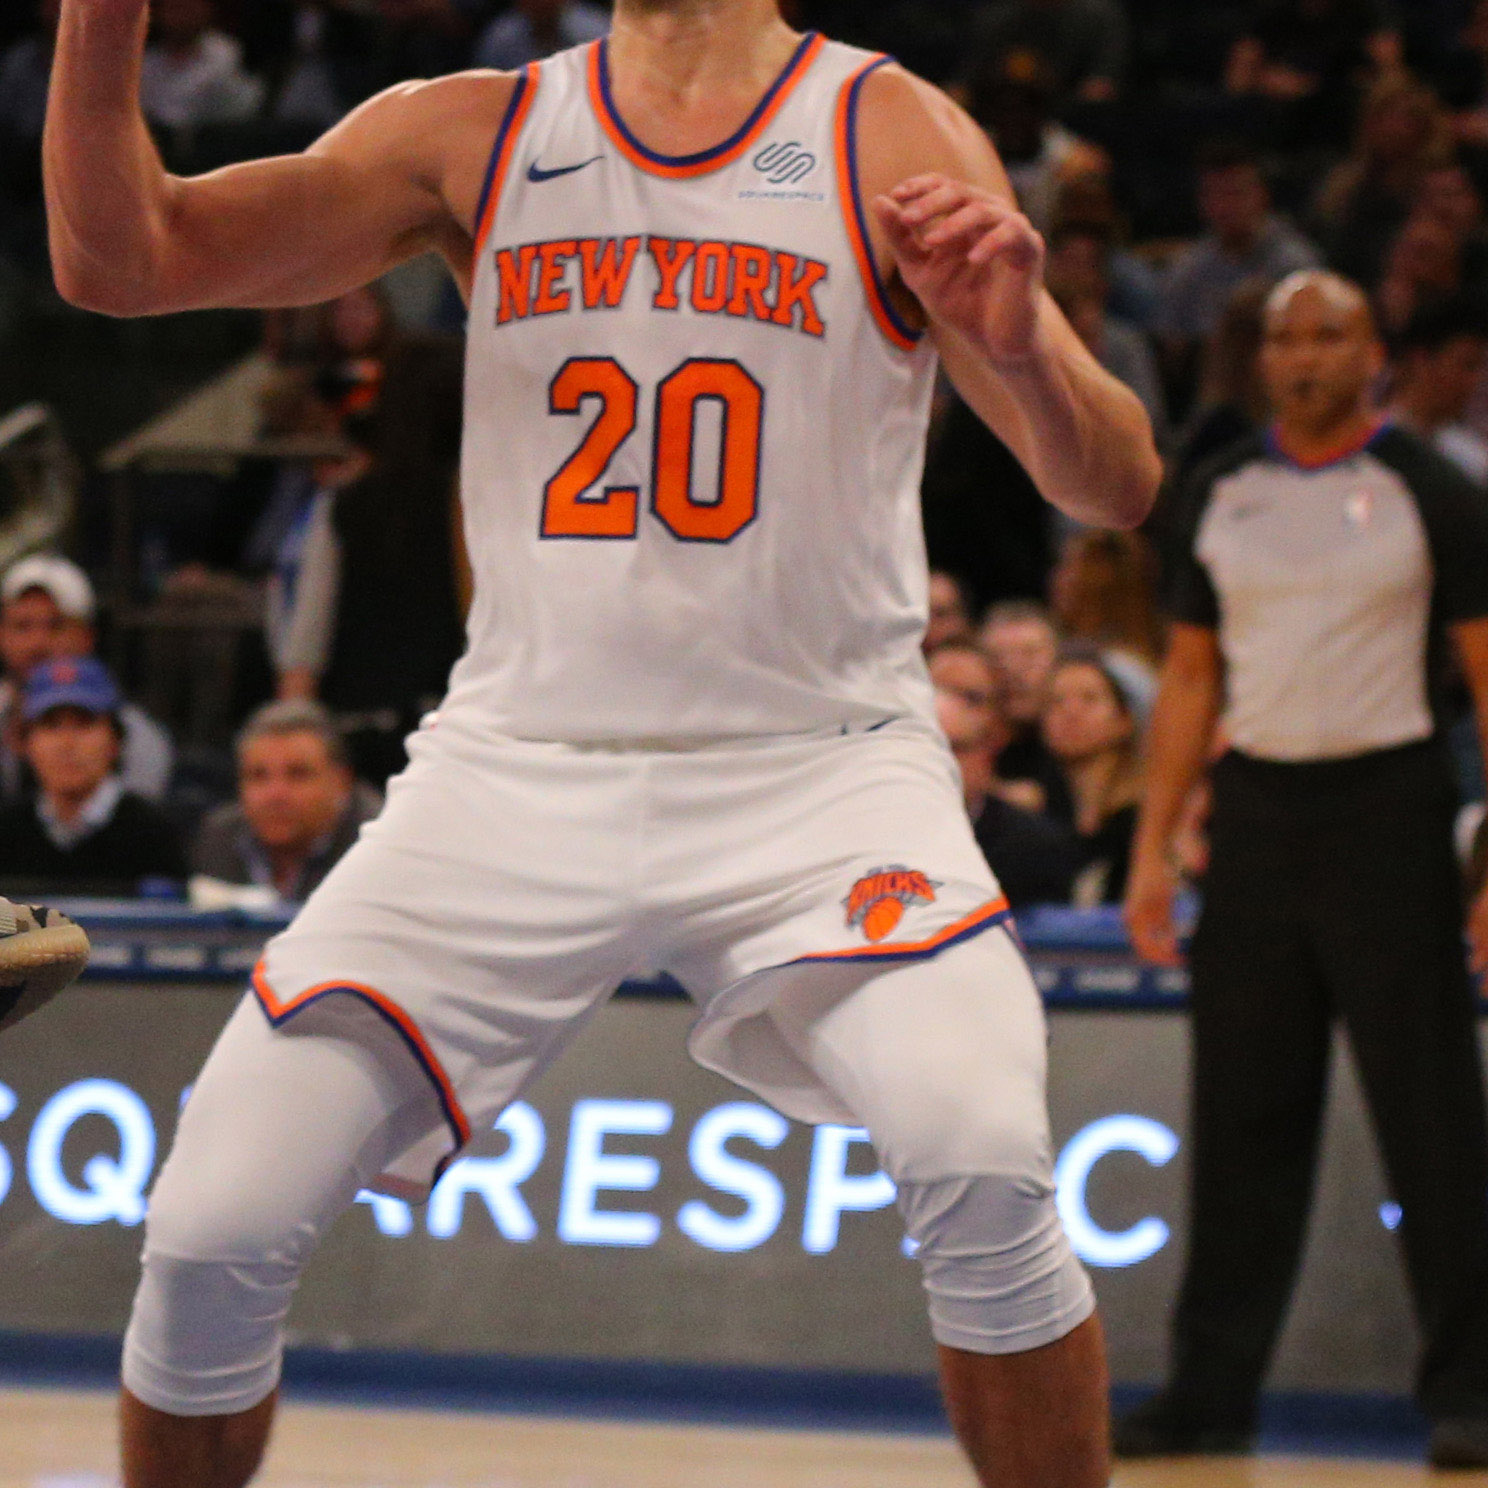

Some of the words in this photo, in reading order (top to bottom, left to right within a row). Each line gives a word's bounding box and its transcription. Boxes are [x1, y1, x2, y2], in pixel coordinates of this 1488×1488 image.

[494, 234, 645, 328] NEW
[646, 232, 829, 340] YORK
[538, 355, 765, 545] 20
